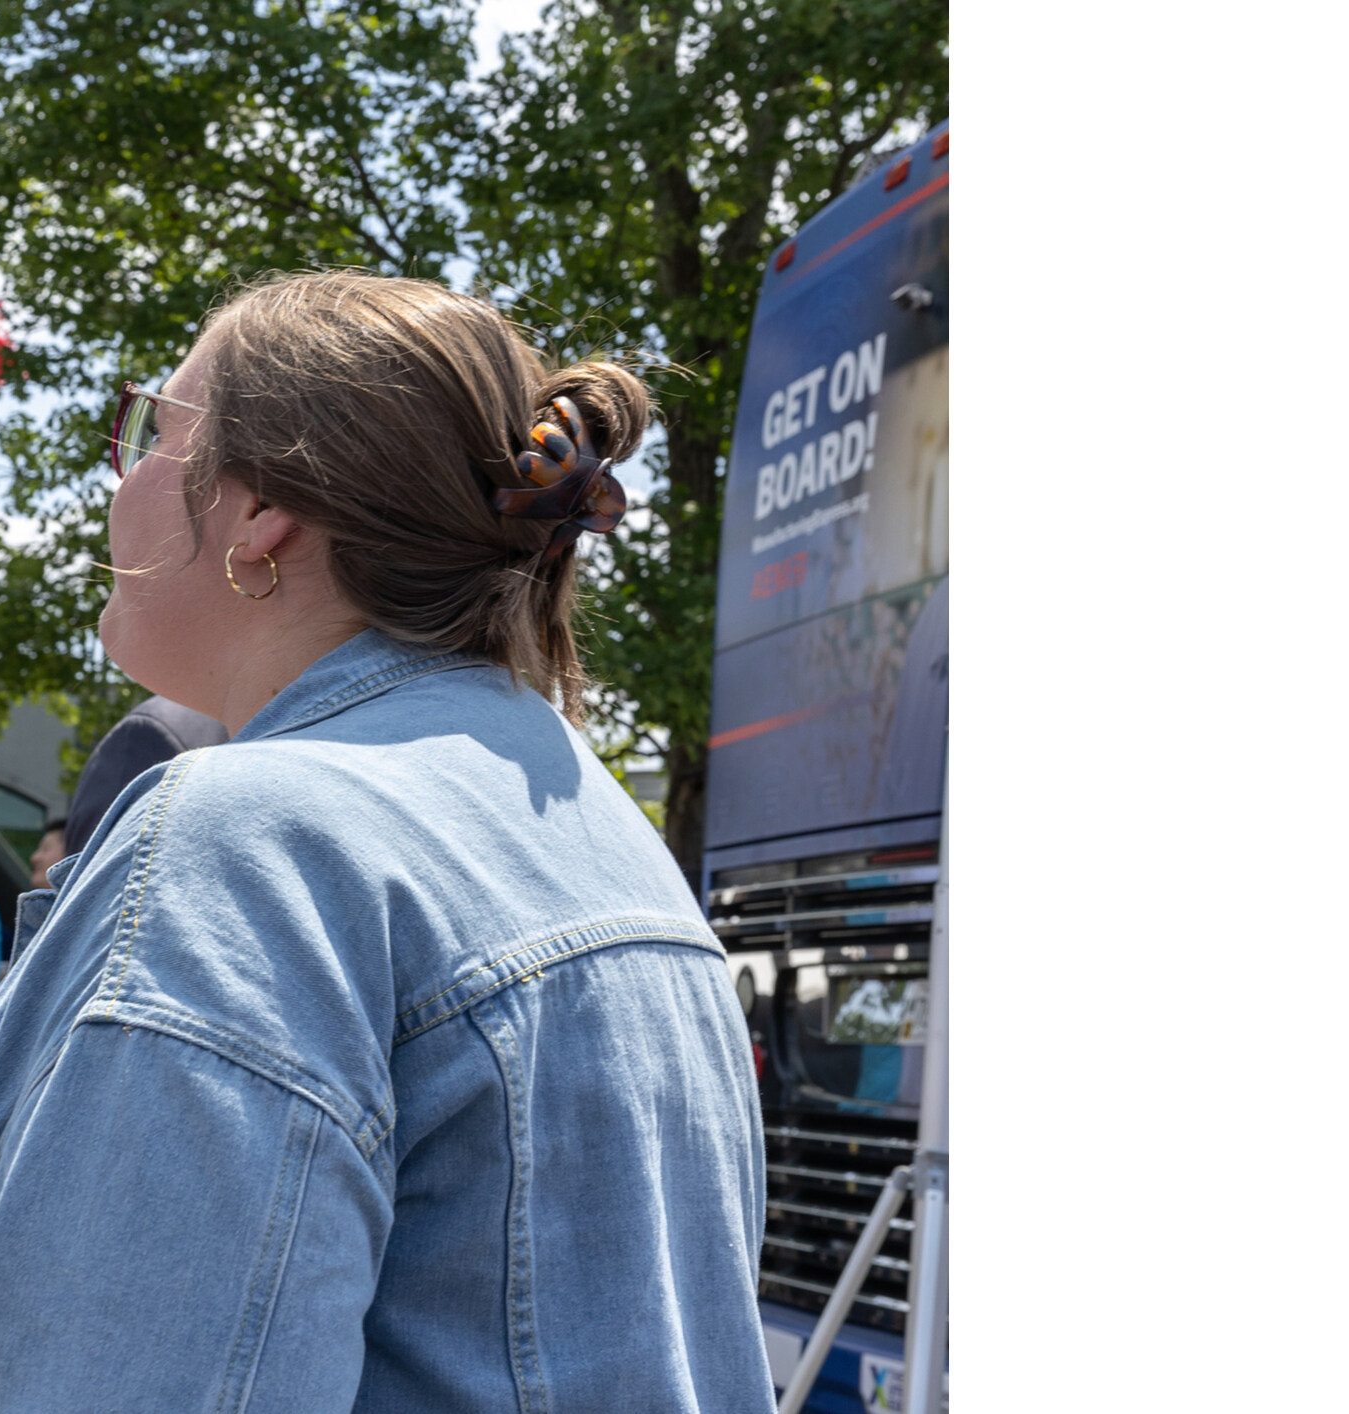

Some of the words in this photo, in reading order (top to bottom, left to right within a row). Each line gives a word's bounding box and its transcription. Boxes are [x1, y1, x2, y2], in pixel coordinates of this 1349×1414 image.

[762, 364, 827, 449] GET
[828, 332, 887, 414] ON
[753, 410, 879, 521] BOARD!
